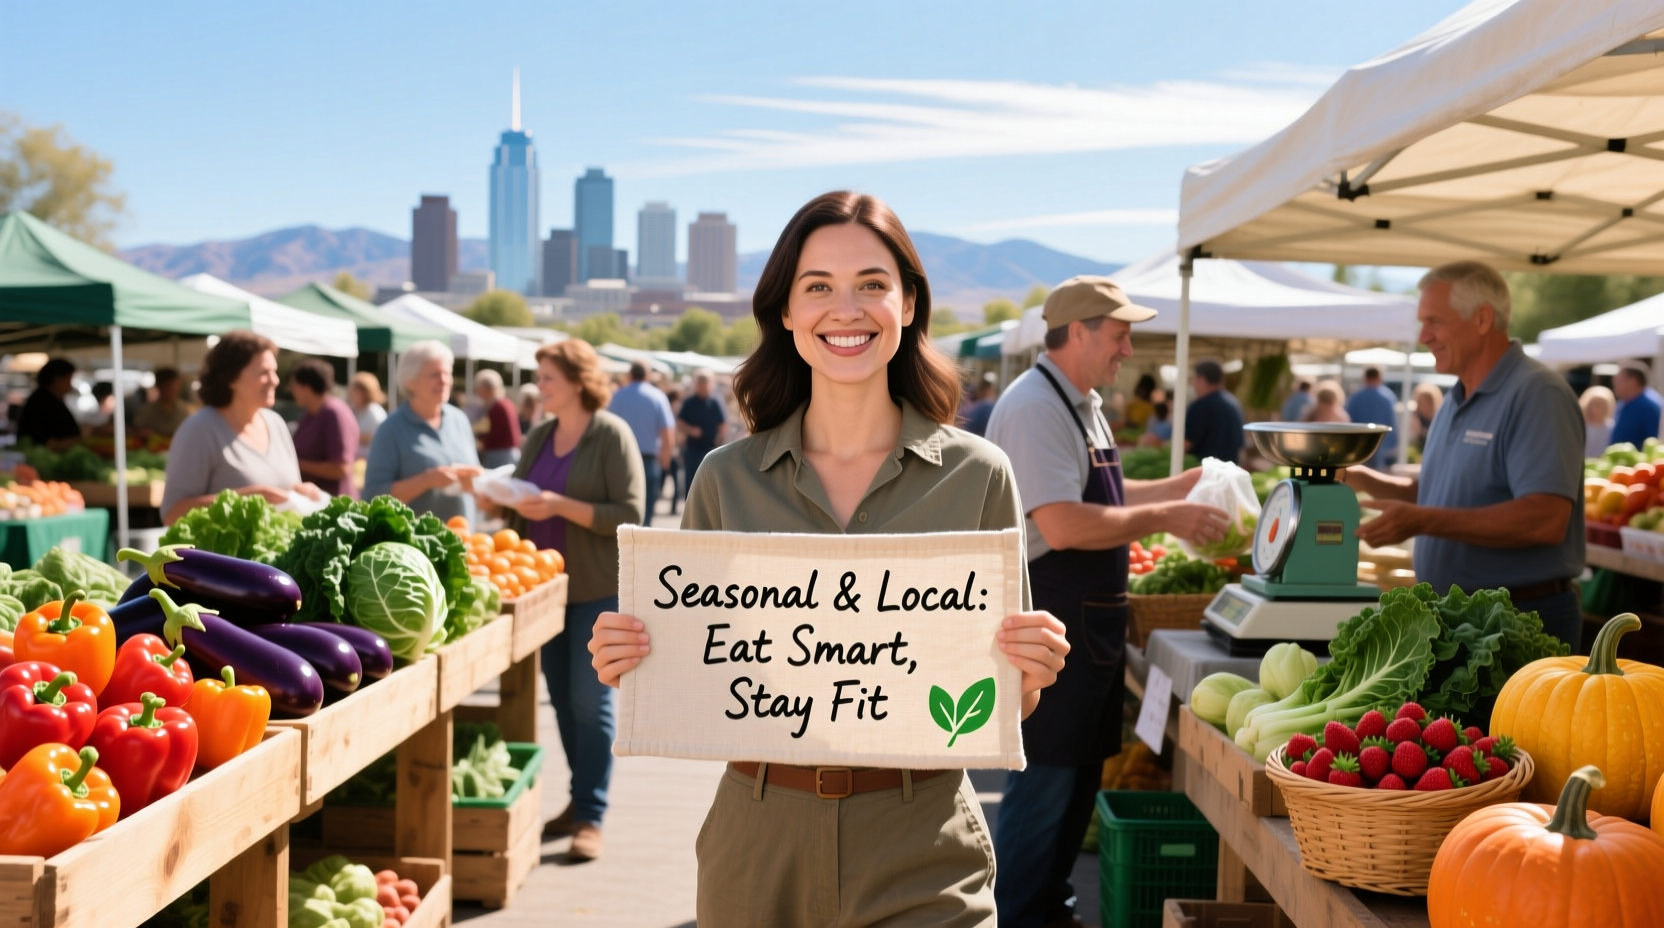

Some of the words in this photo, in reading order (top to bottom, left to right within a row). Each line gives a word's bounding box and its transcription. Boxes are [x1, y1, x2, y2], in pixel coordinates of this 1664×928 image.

[653, 564, 819, 610] Seasonal
[833, 571, 862, 614] &
[877, 569, 988, 613] Local:
[703, 623, 773, 665] Eat
[787, 623, 918, 675] Smart,
[725, 676, 814, 739] Stay
[831, 679, 889, 723] Fit
